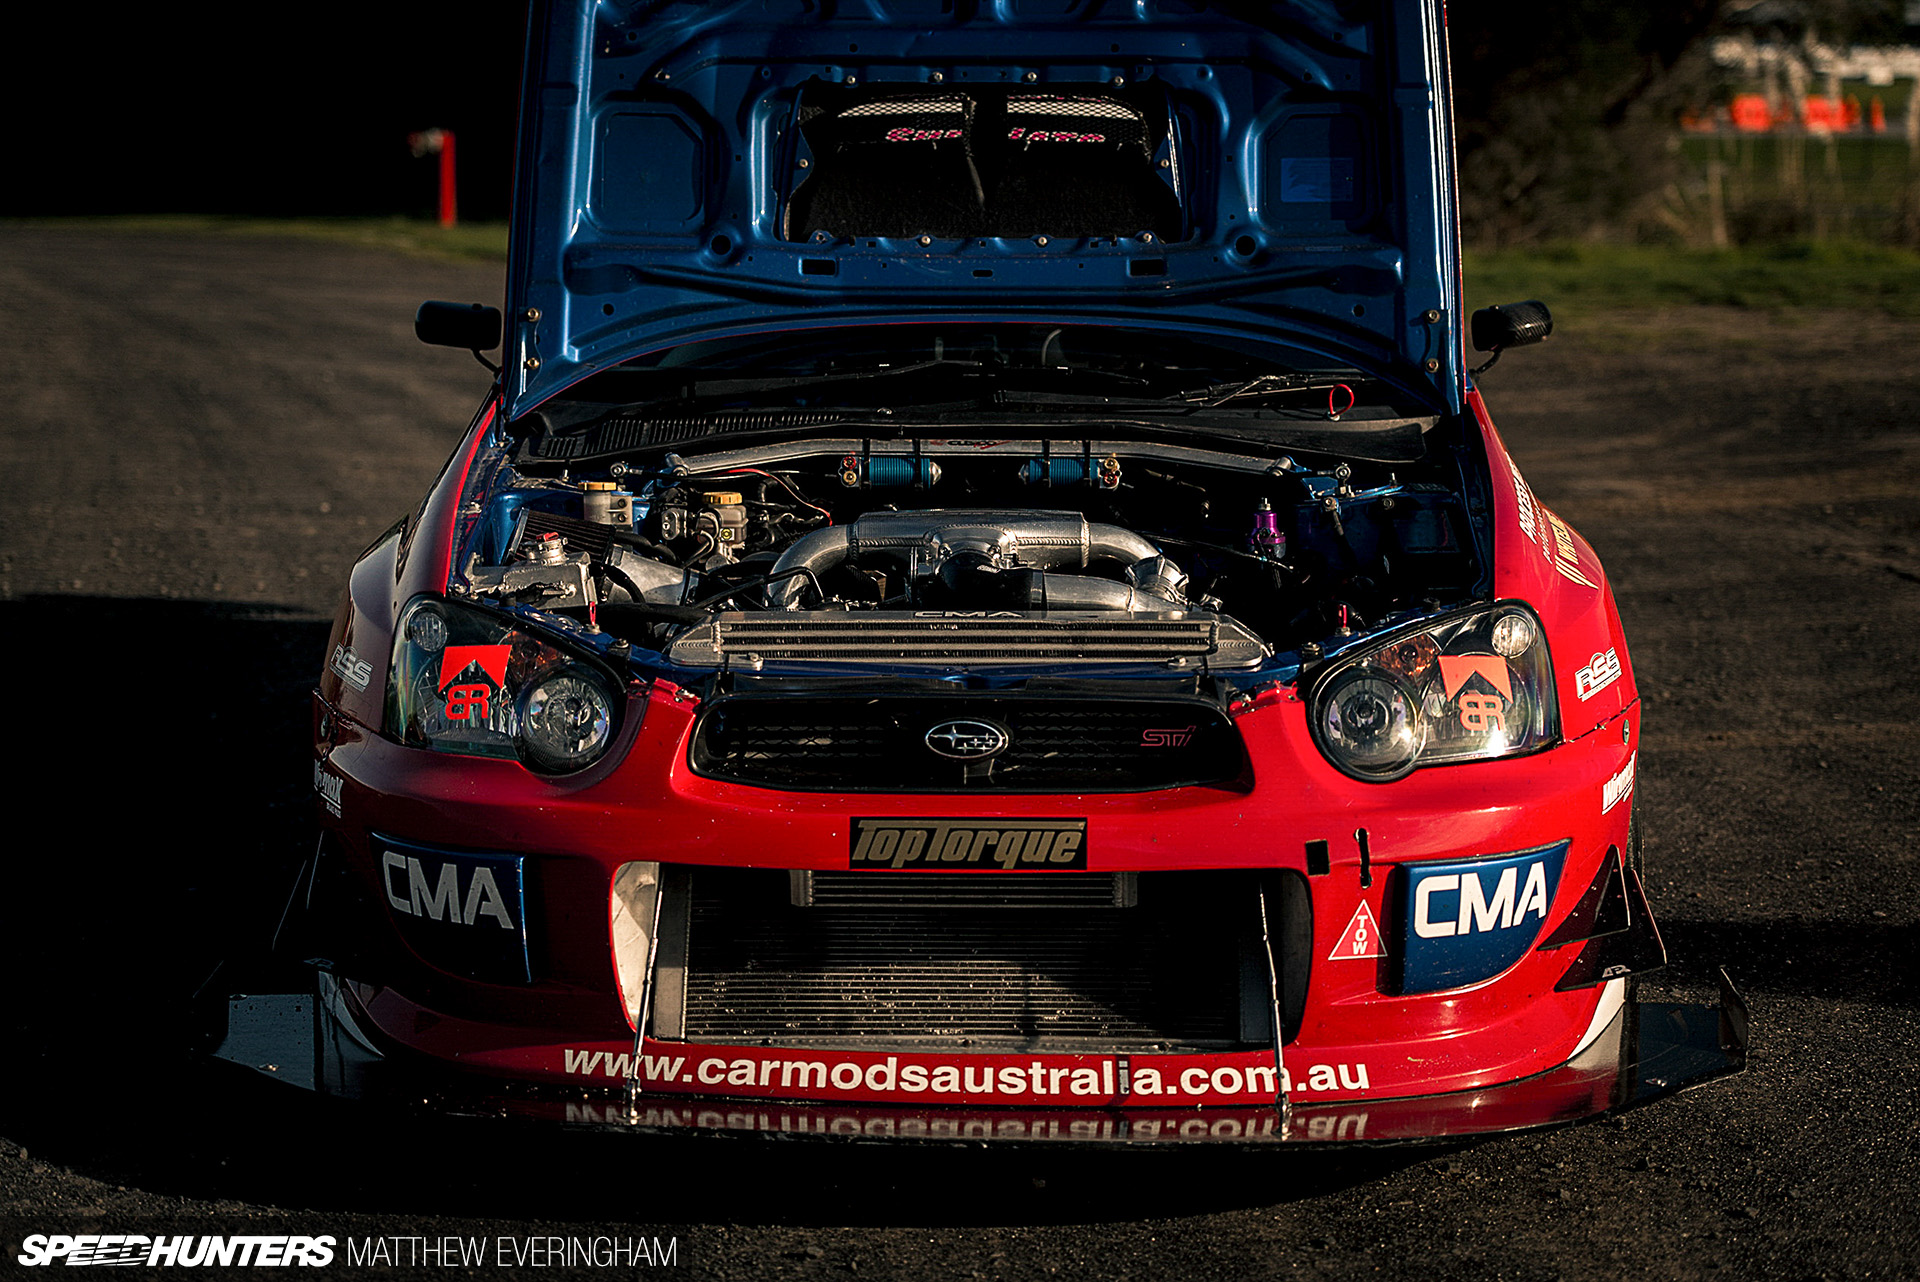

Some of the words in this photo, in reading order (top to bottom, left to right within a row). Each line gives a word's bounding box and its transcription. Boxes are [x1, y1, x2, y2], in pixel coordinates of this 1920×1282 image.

[1544, 509, 1579, 565] WHITELE
[383, 850, 515, 930] CMA
[1414, 861, 1547, 939] CMA
[1352, 914, 1369, 956] TOW
[564, 1048, 1370, 1095] www.carmodsaustralia.com.au
